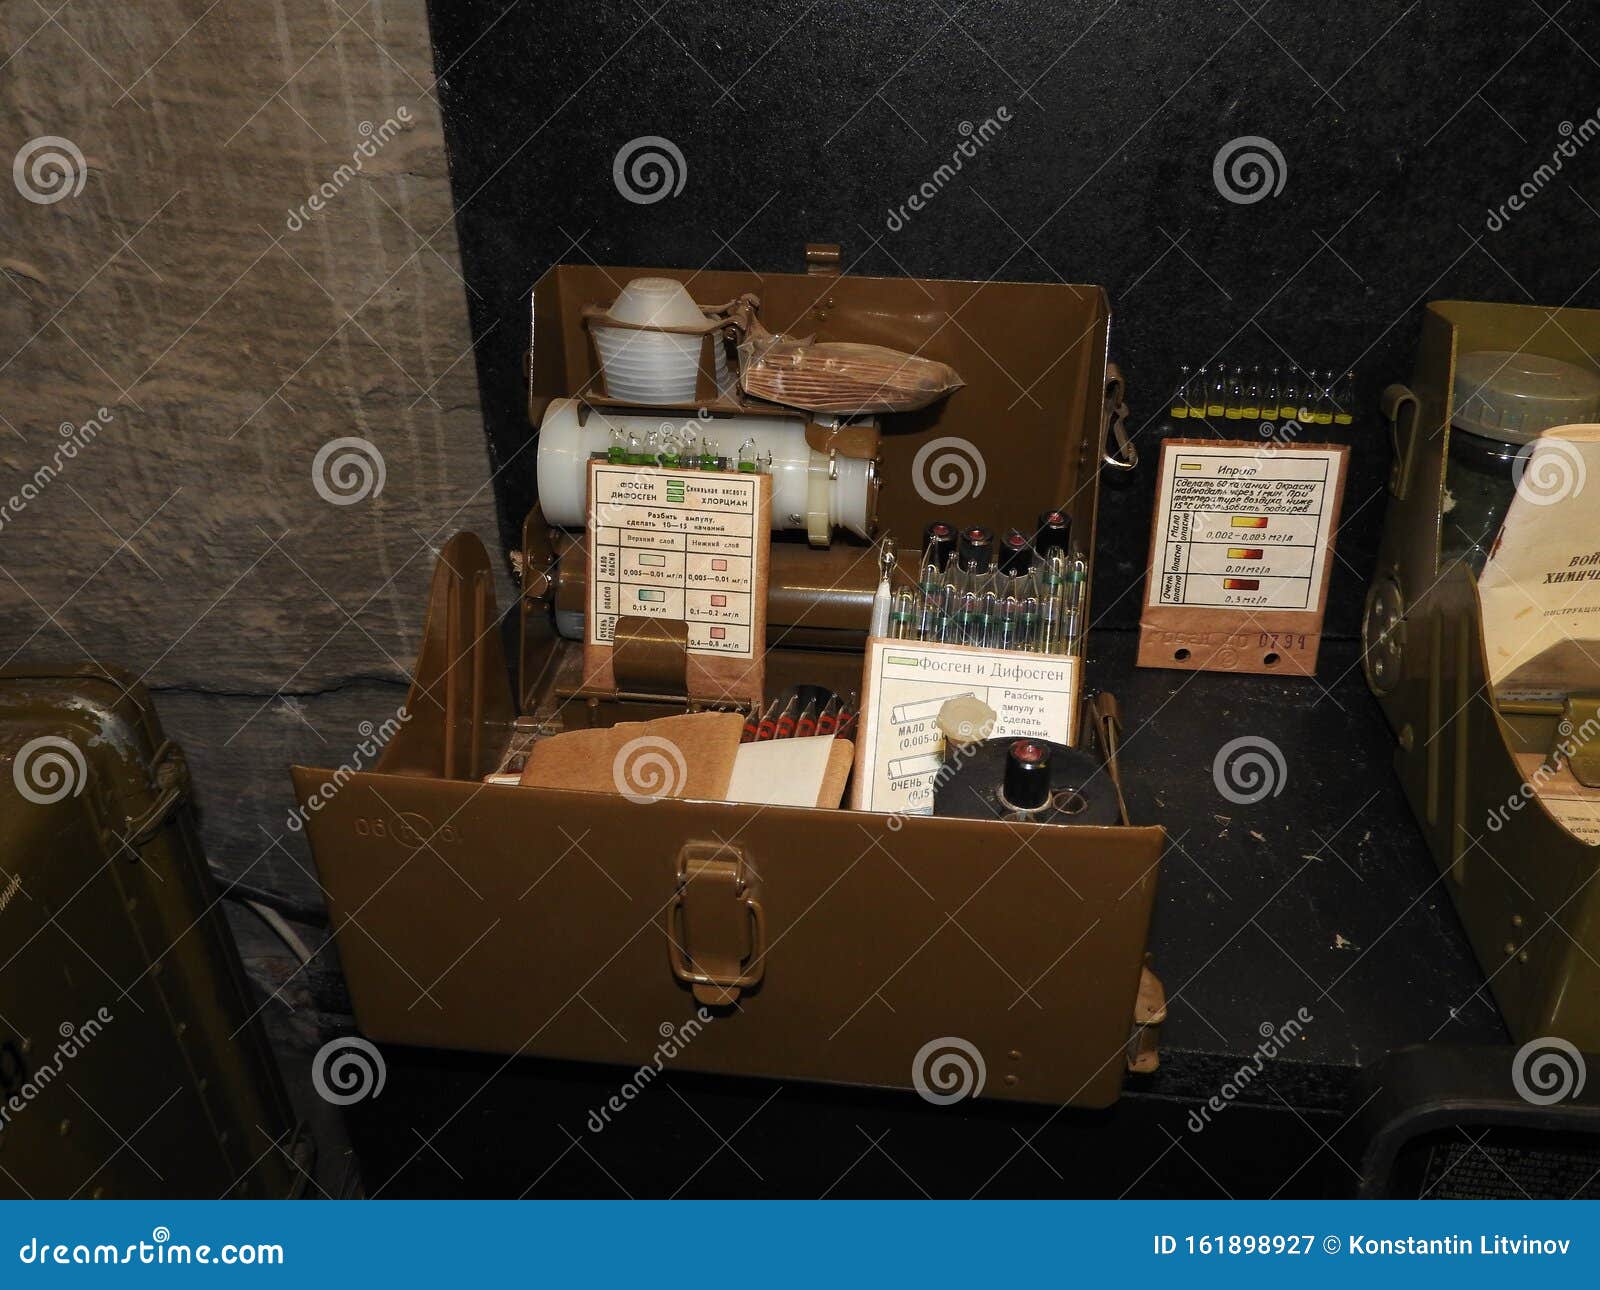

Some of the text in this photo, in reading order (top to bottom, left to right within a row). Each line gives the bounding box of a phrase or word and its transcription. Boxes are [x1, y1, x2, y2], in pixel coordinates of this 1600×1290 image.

[1217, 465, 1257, 477] Иприт
[620, 482, 654, 490] ФОСГЕН
[1216, 480, 1228, 488] 60
[610, 491, 657, 501] ДИФОСГЕН
[701, 498, 748, 507] ХЛОРЦИАН
[647, 511, 678, 520] Разбить
[626, 534, 675, 545] Верхний слой
[691, 539, 721, 547] Нижний
[1568, 551, 1600, 567] ВОЙ
[919, 656, 1064, 682] Фосген и Дифосген
[1004, 690, 1044, 701] Разбить
[1002, 704, 1034, 715] ампулу
[1002, 716, 1041, 726] сделать
[898, 722, 925, 736] МАЛО
[996, 726, 1006, 734] 15
[890, 777, 922, 792] ОЧЕНЬ
